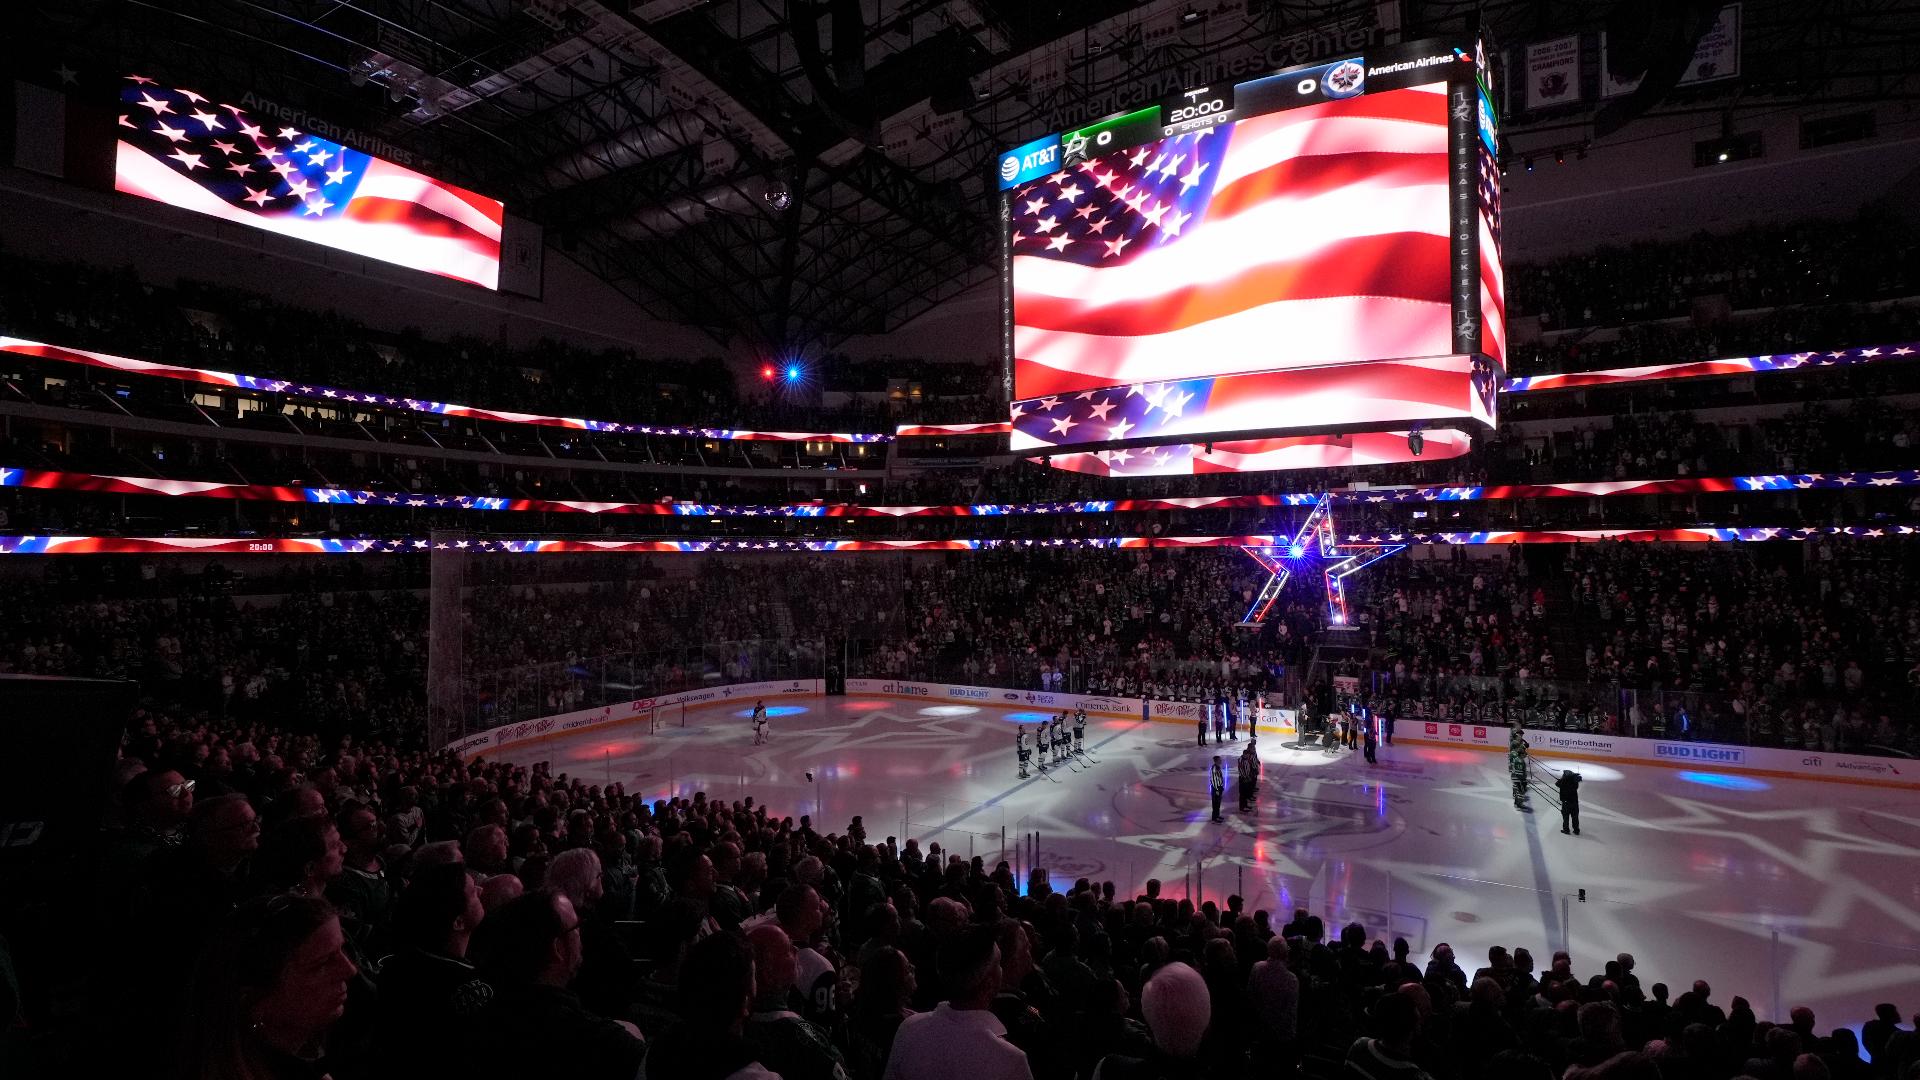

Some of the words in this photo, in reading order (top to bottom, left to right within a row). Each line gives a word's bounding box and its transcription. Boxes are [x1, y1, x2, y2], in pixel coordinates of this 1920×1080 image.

[1367, 62, 1415, 77] American
[1415, 54, 1455, 68] Airlines
[1532, 56, 1574, 72] CHAMPIONS
[1297, 79, 1316, 95] 0
[1170, 99, 1224, 123] 20:00
[239, 91, 340, 140] American
[343, 129, 414, 166] Airlines
[1181, 117, 1213, 131] SHOTS
[1097, 131, 1112, 146] 0
[1021, 144, 1058, 172] AT&T
[1457, 132, 1469, 200] TEXAS
[1459, 218, 1472, 301] HOCKEY
[249, 543, 273, 551] 20:00
[882, 682, 895, 694] at
[896, 681, 929, 696] home
[949, 688, 965, 697] BUD
[966, 690, 990, 699] LIGHT
[677, 692, 715, 703] Volkswagen
[1549, 737, 1612, 749] Higginbotham
[1656, 744, 1689, 757] BUD
[1690, 747, 1741, 761] LIGHT
[1802, 756, 1822, 767] citi
